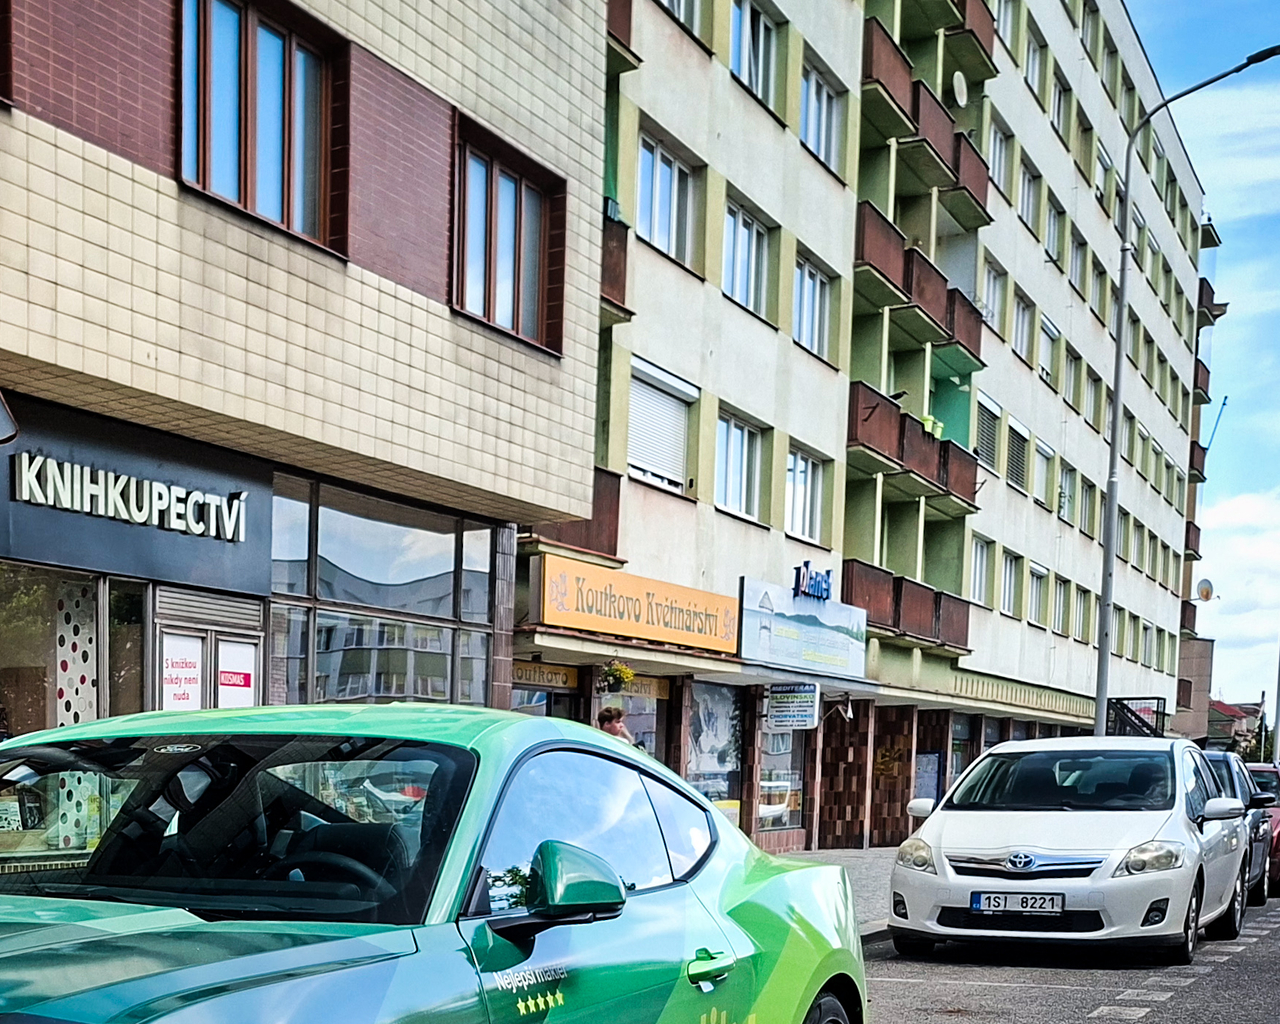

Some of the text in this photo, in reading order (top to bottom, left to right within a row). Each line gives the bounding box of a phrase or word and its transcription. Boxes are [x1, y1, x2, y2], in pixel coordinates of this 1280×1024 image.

[22, 452, 249, 543] KNIHKUPECTVÍ
[574, 576, 719, 637] Koutkovo Květinářství
[170, 657, 197, 669] knížkou
[164, 674, 198, 687] nikdy není
[173, 689, 189, 701] nuda
[1020, 896, 1055, 910] 8221
[493, 966, 537, 994] Nejlepší
